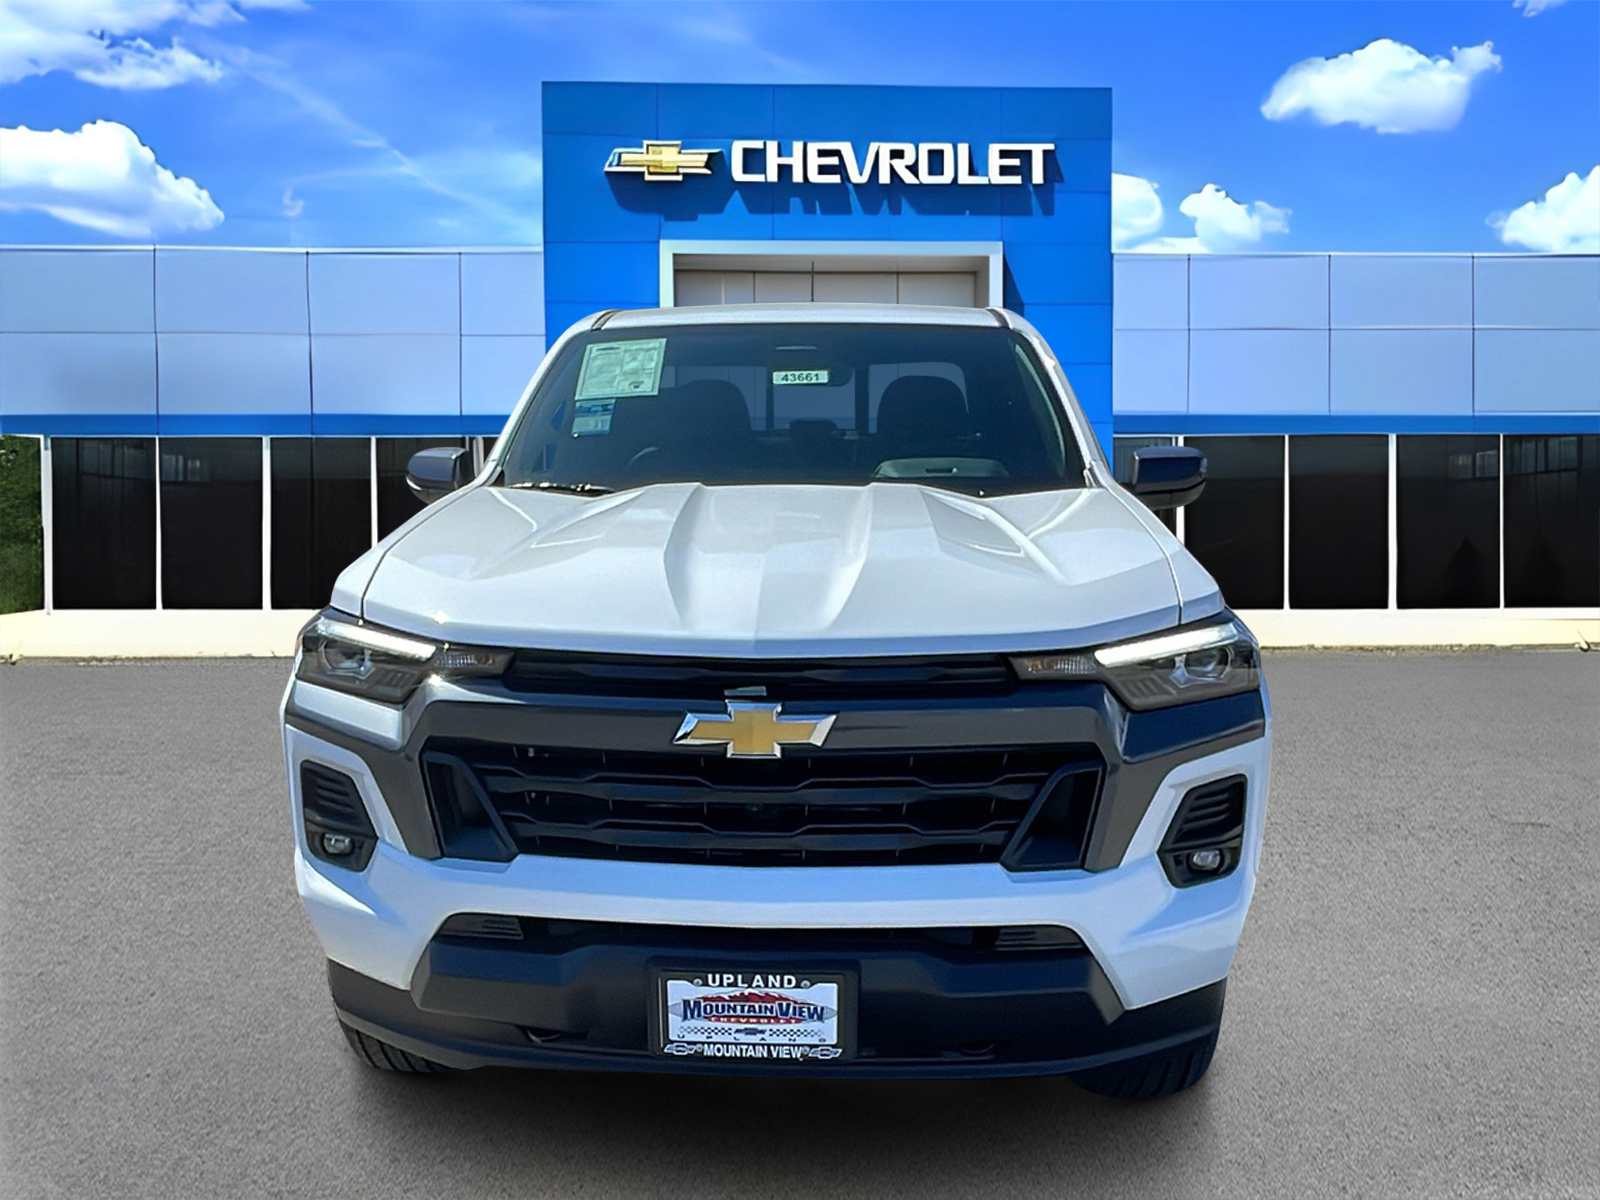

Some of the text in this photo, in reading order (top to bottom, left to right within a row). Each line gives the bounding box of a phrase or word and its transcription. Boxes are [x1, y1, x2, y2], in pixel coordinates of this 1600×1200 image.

[731, 140, 1055, 185] CHEVROLET
[781, 373, 820, 383] 43661
[707, 973, 797, 988] UPLAND
[703, 1044, 802, 1059] MOUNTAIN VIEW
